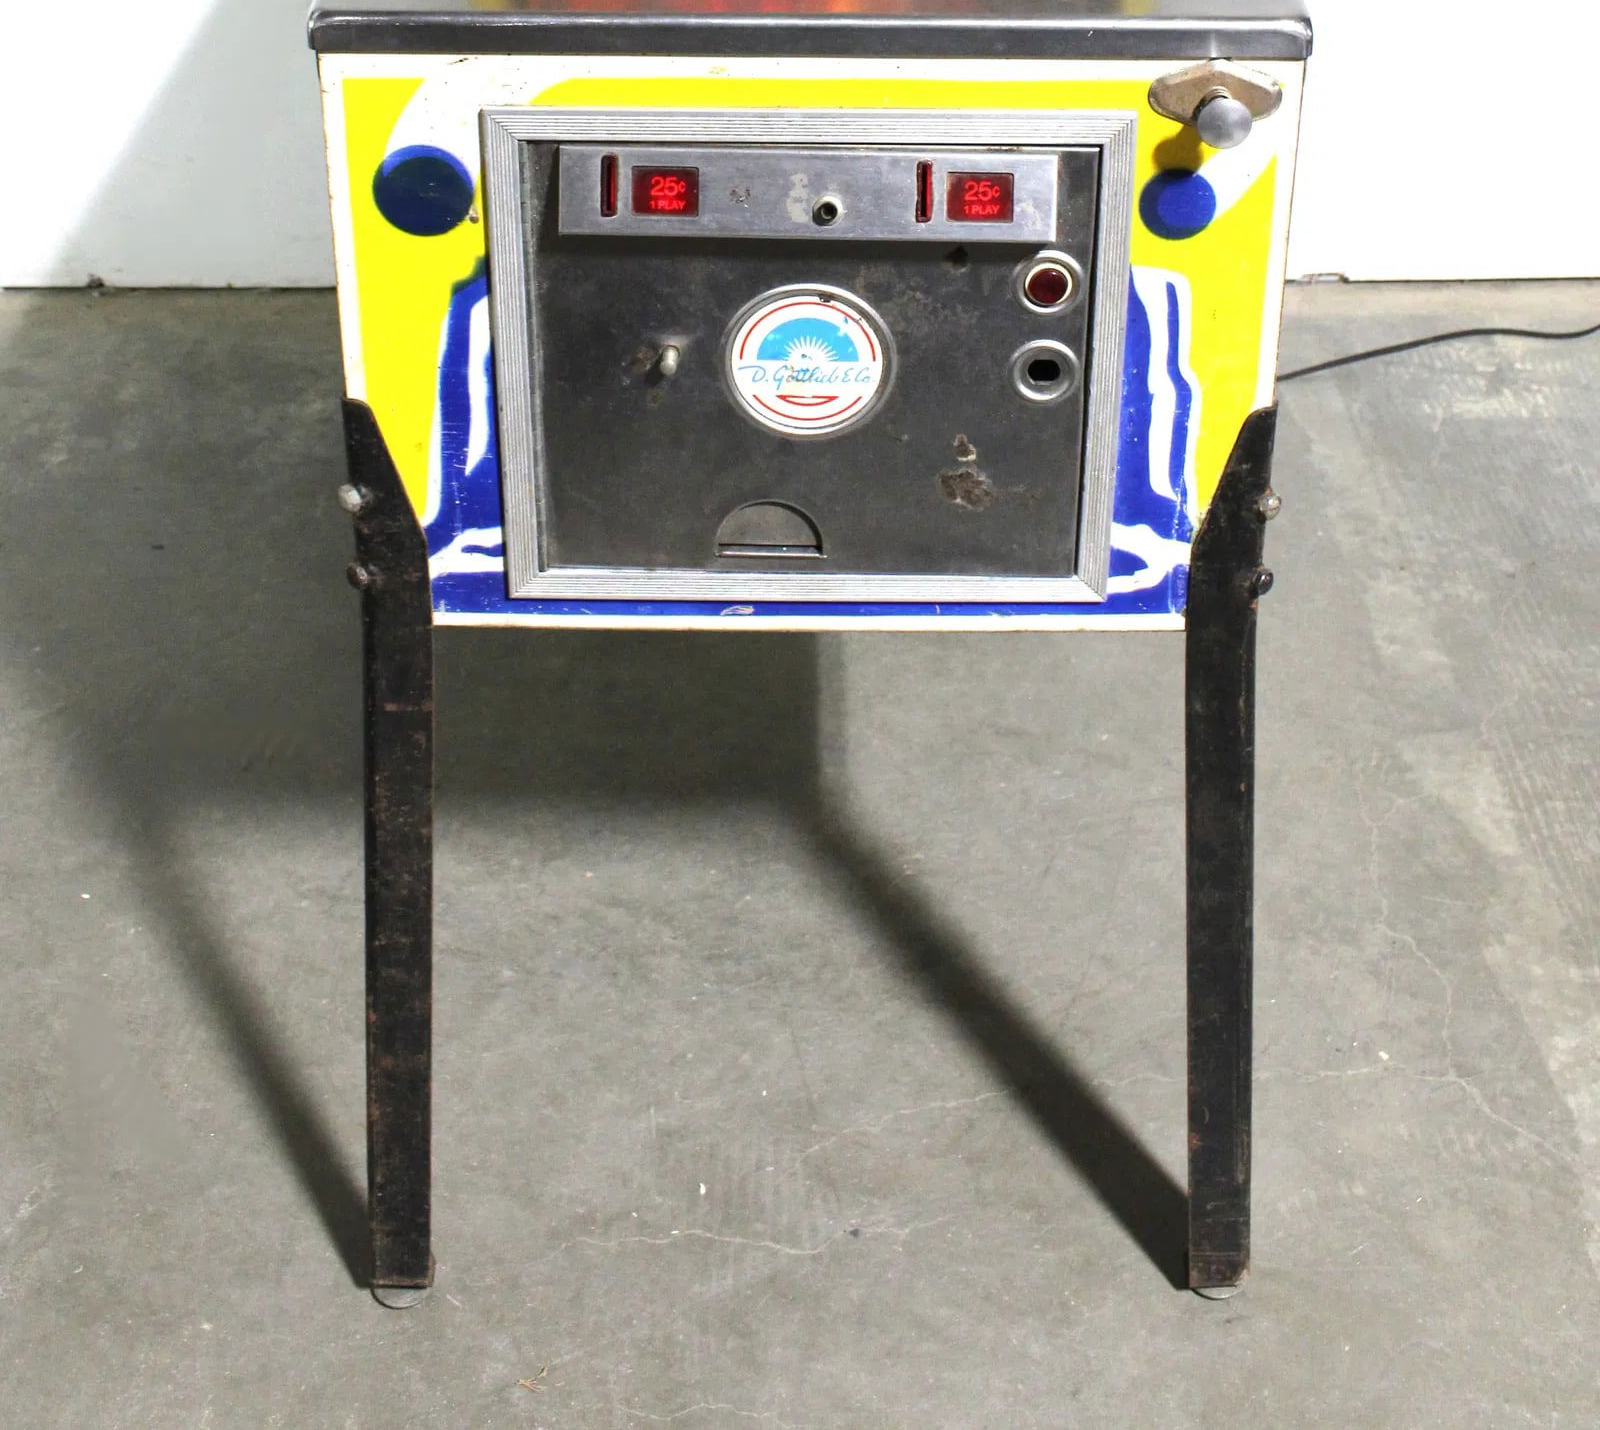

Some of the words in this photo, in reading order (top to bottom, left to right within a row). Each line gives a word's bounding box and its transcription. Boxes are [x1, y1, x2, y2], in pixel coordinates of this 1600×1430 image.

[650, 176, 686, 196] 25¢
[963, 180, 1000, 201] 25¢
[657, 200, 687, 210] PLAY
[971, 204, 1000, 215] PLAY
[772, 364, 840, 390] Gottlieb
